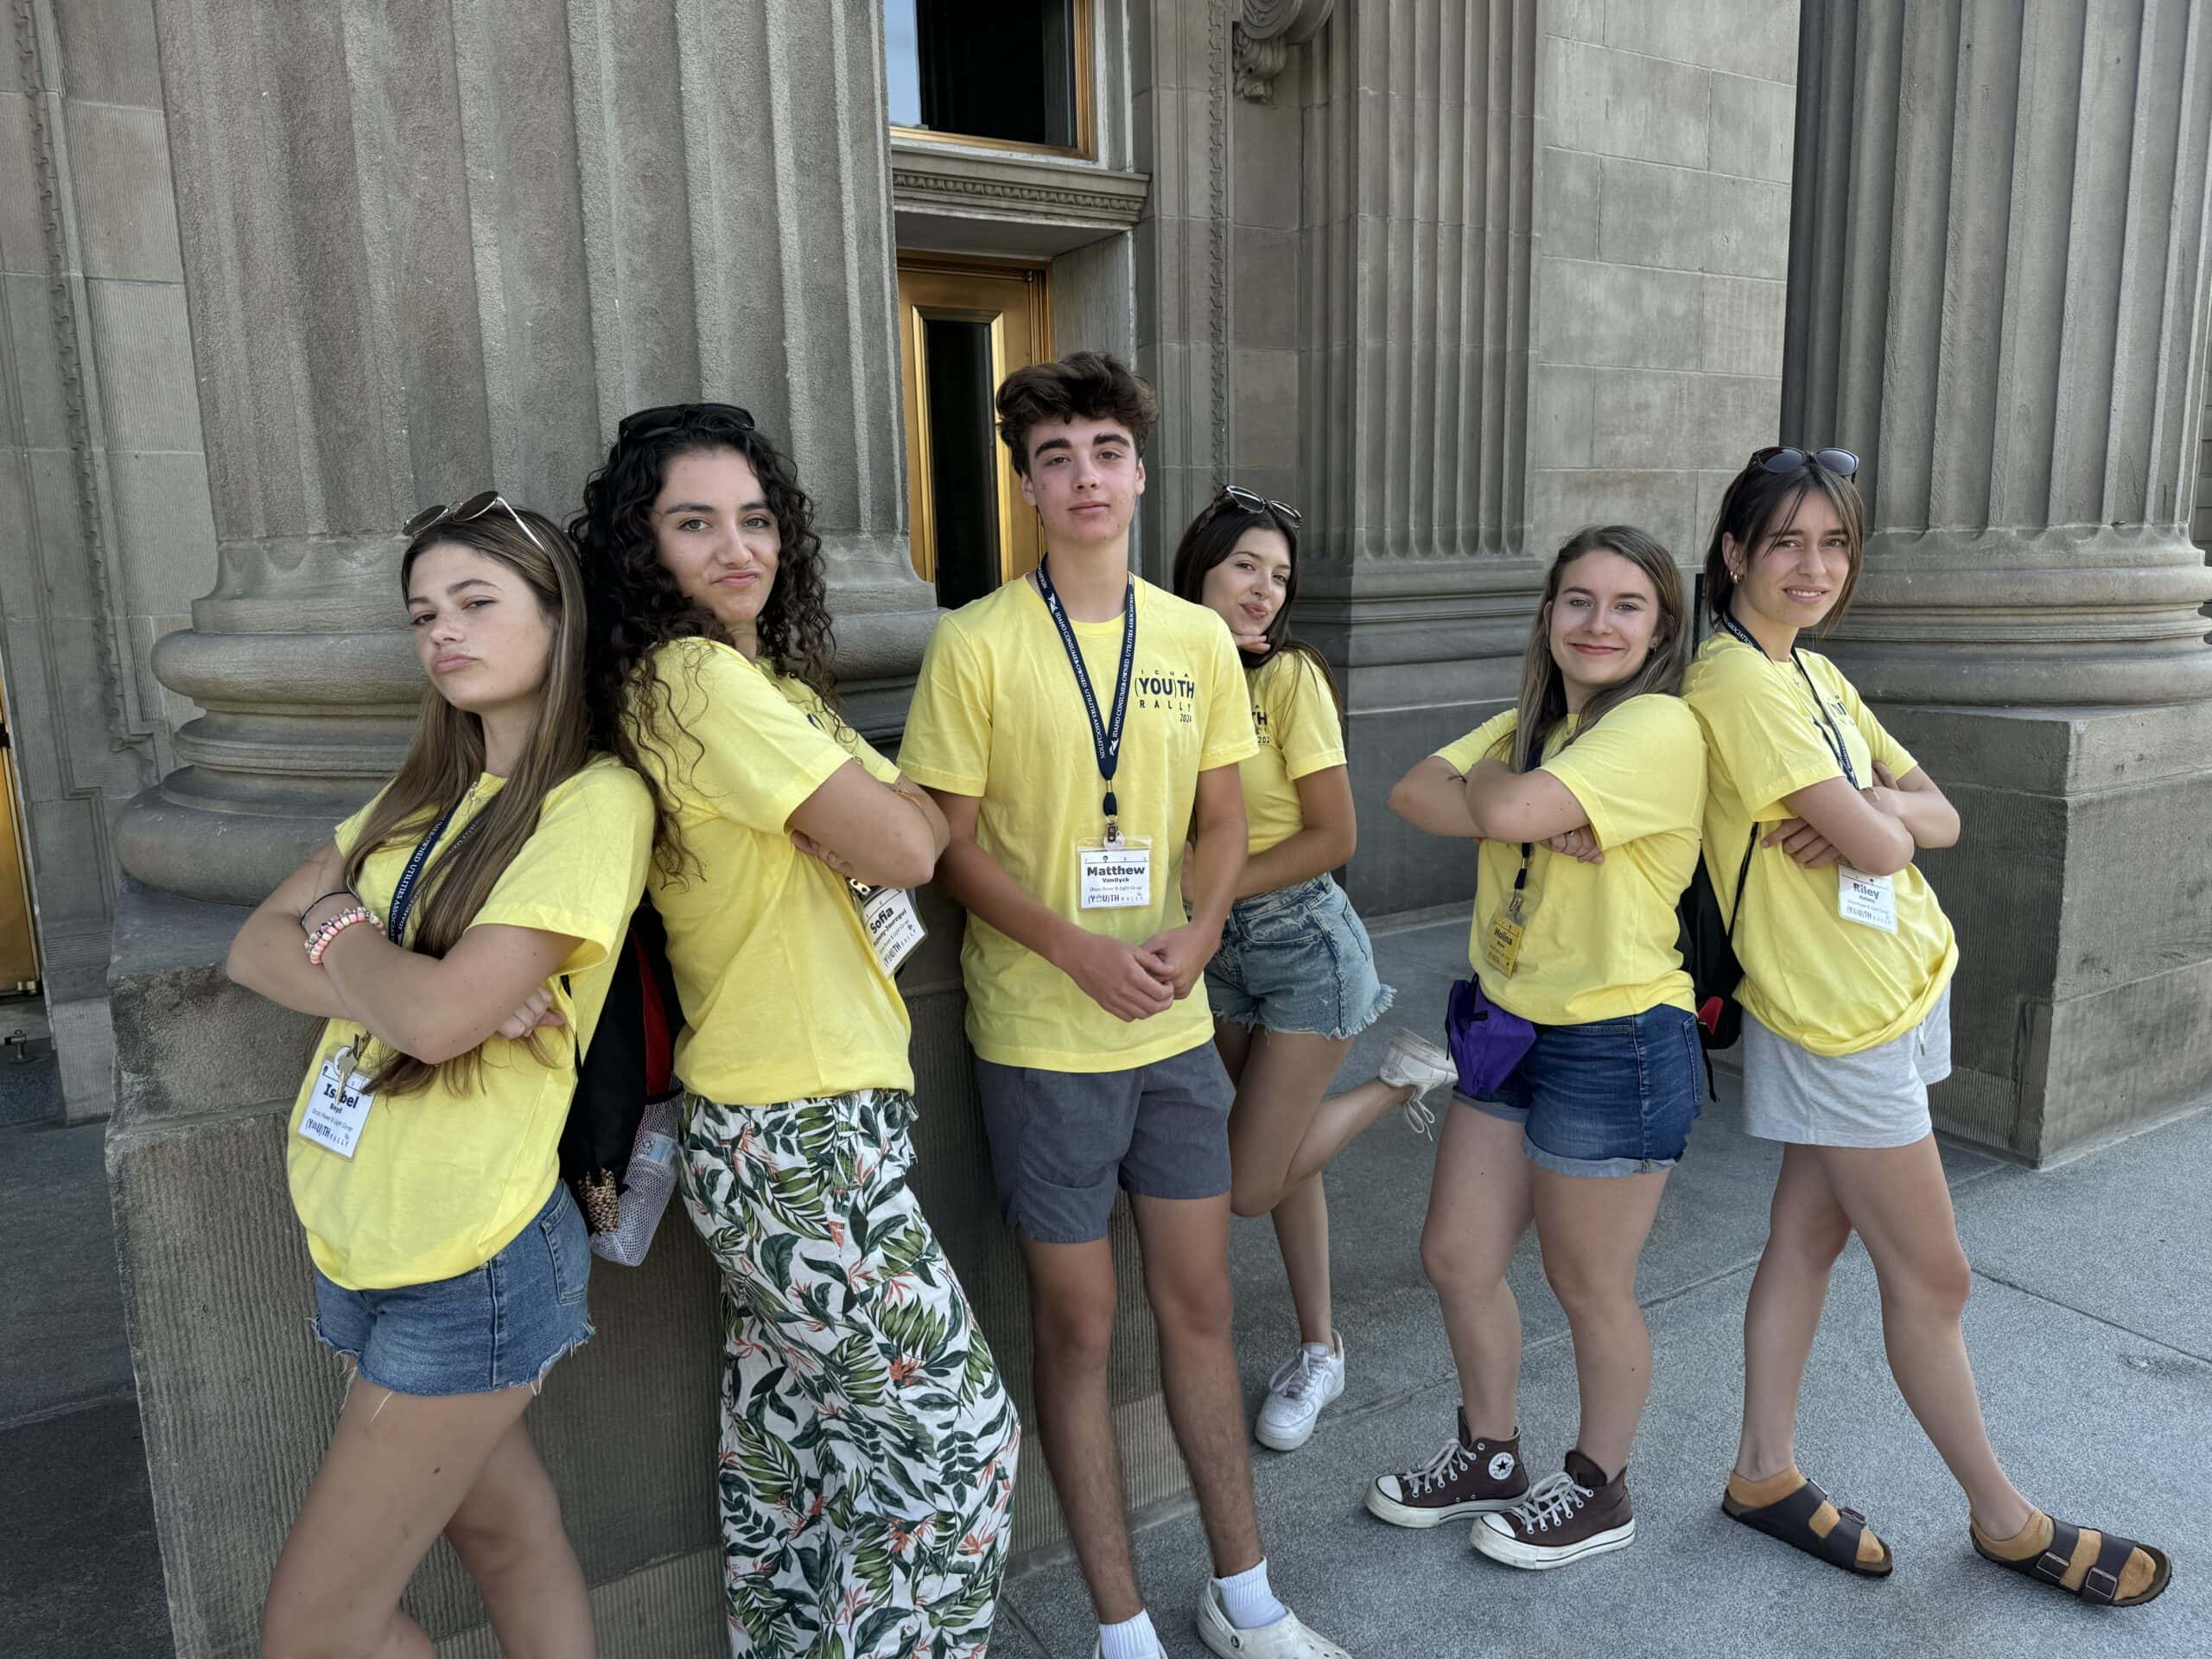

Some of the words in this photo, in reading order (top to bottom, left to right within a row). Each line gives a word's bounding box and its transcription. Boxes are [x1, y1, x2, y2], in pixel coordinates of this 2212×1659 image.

[1055, 612, 1067, 631] IDAHO
[1084, 689, 1097, 718] UTILITIES
[1093, 718, 1106, 759] ASSOCIATION
[397, 864, 418, 899] UTILITIES
[1087, 865, 1145, 876] Matthew
[1853, 882, 1879, 899] Riley
[870, 907, 894, 934] Sofia
[323, 1083, 359, 1109] Isbel
